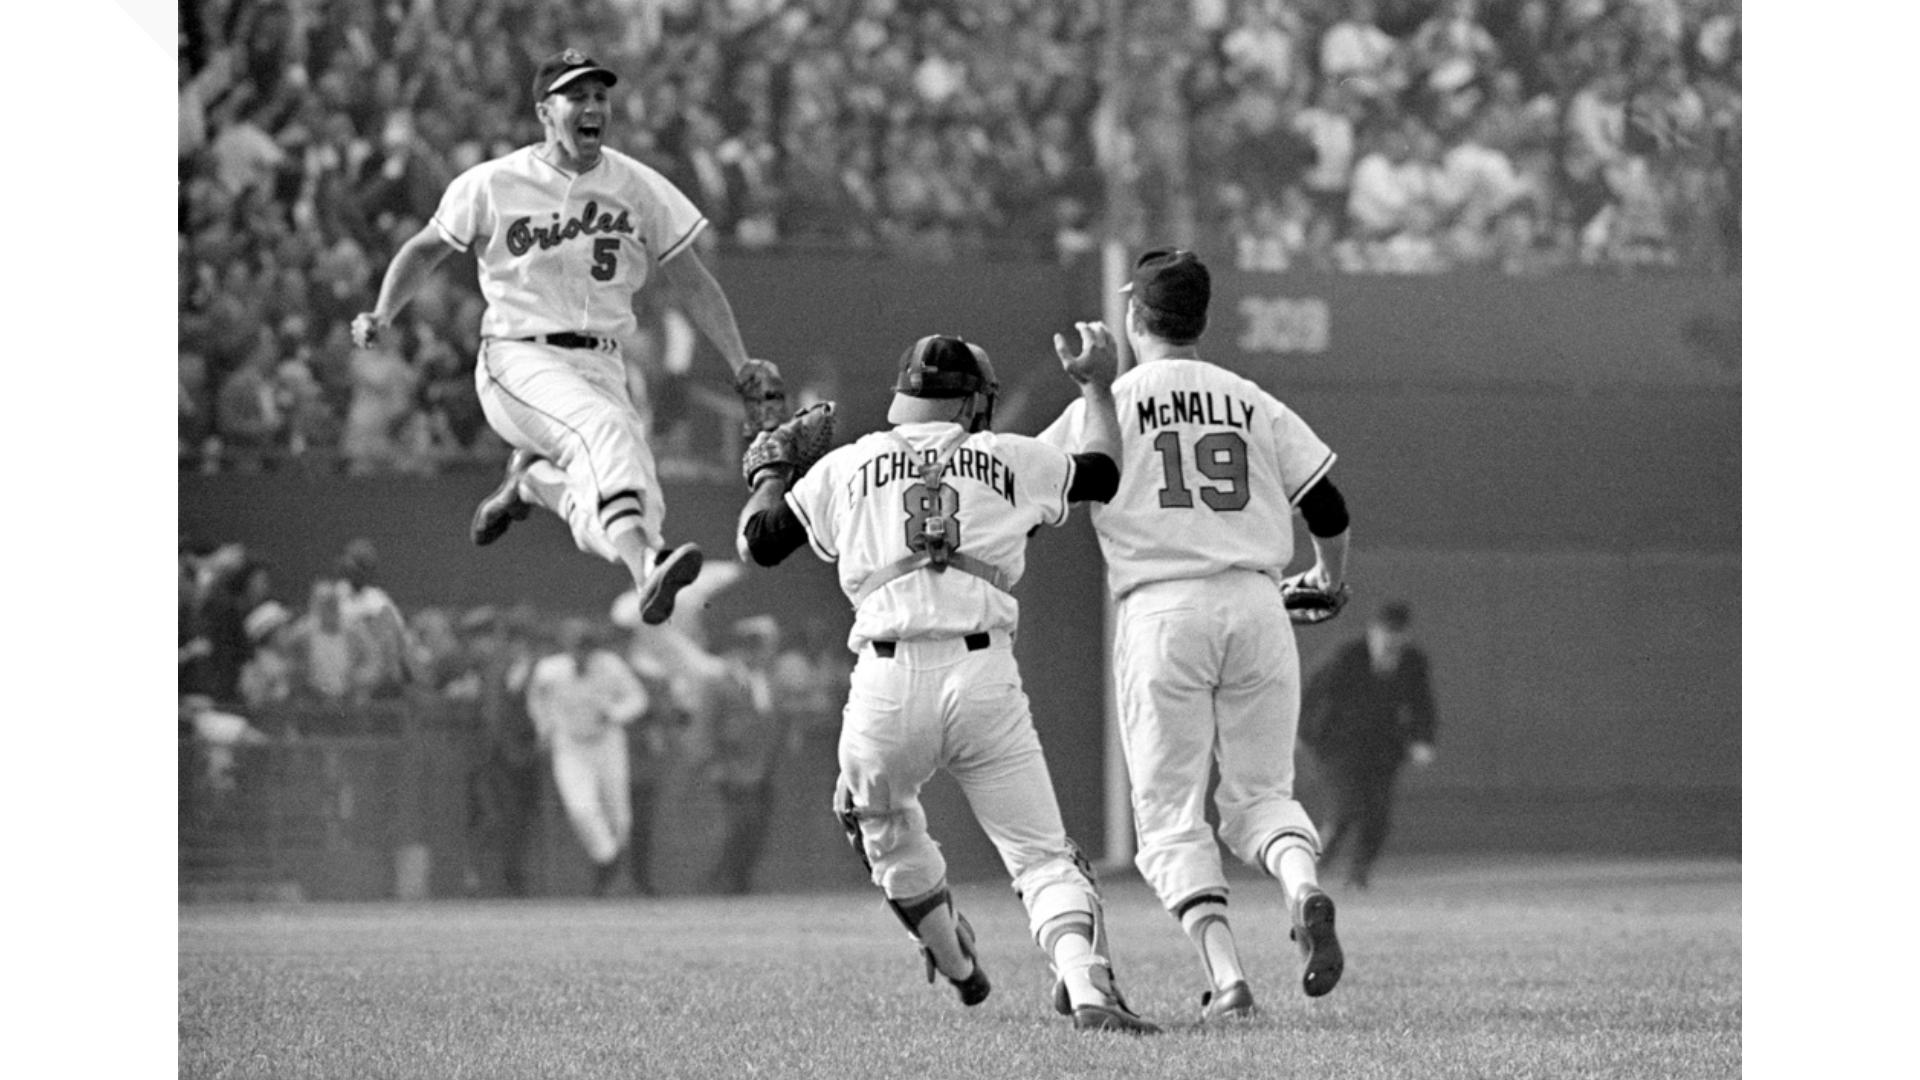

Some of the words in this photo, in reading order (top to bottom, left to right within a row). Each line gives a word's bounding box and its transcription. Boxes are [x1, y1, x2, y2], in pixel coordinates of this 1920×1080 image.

[506, 201, 634, 257] Orioles
[590, 238, 621, 281] 5
[1137, 391, 1254, 435] McNALLY
[1154, 431, 1251, 511] 19
[903, 482, 961, 553] 8
